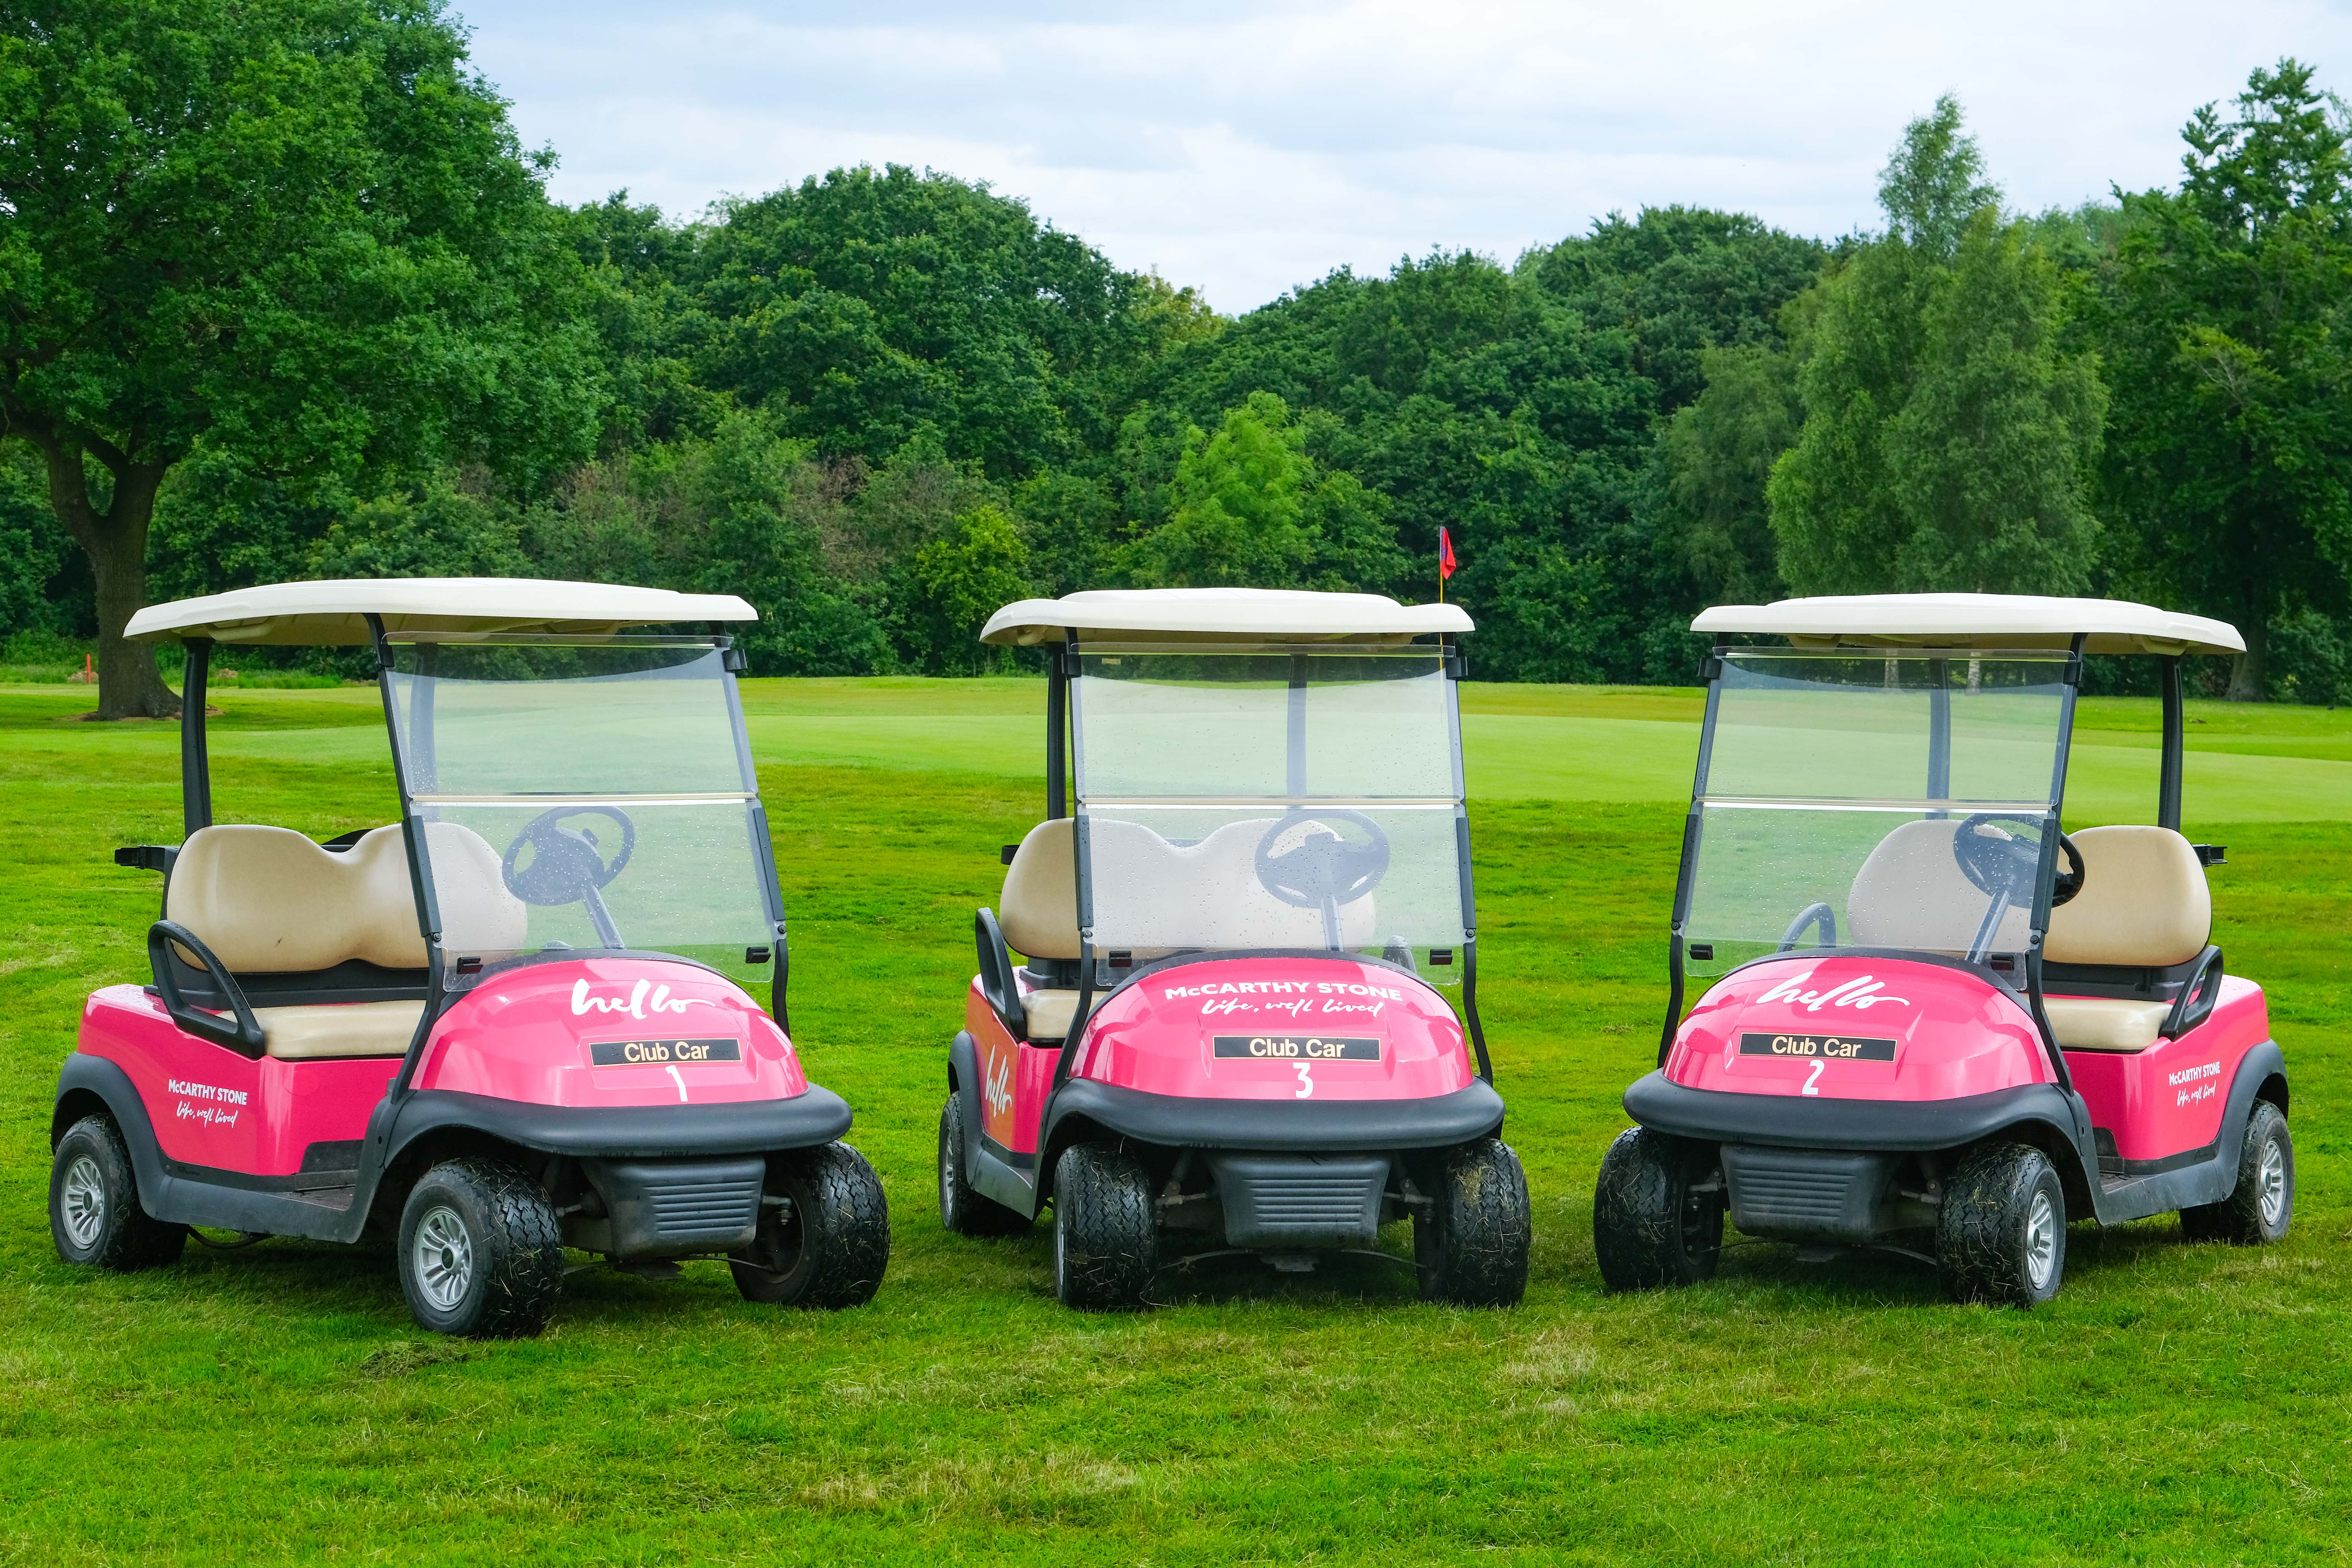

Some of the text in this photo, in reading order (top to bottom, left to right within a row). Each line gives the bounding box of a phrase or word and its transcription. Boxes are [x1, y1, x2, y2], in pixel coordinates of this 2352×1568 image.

[571, 978, 716, 1020] hello
[1165, 982, 1404, 1002] McCARTHY STONE
[1756, 971, 1910, 1012] hello
[1263, 998, 1314, 1018] well
[1322, 998, 1384, 1017] lived
[624, 1041, 710, 1062] Club Car
[1249, 1038, 1346, 1058] Club Car
[1772, 1036, 1862, 1057] Club Car
[665, 1065, 688, 1102] 1
[985, 1044, 1012, 1118] hello
[1292, 1061, 1314, 1099] 3
[1801, 1060, 1825, 1095] 2
[2168, 1061, 2220, 1086] McCARTHY STONE
[168, 1079, 248, 1106] McCARTHY STONE
[2191, 1086, 2203, 1107] well
[2202, 1080, 2217, 1099] lived
[196, 1107, 213, 1128] well
[214, 1107, 239, 1129] lived
